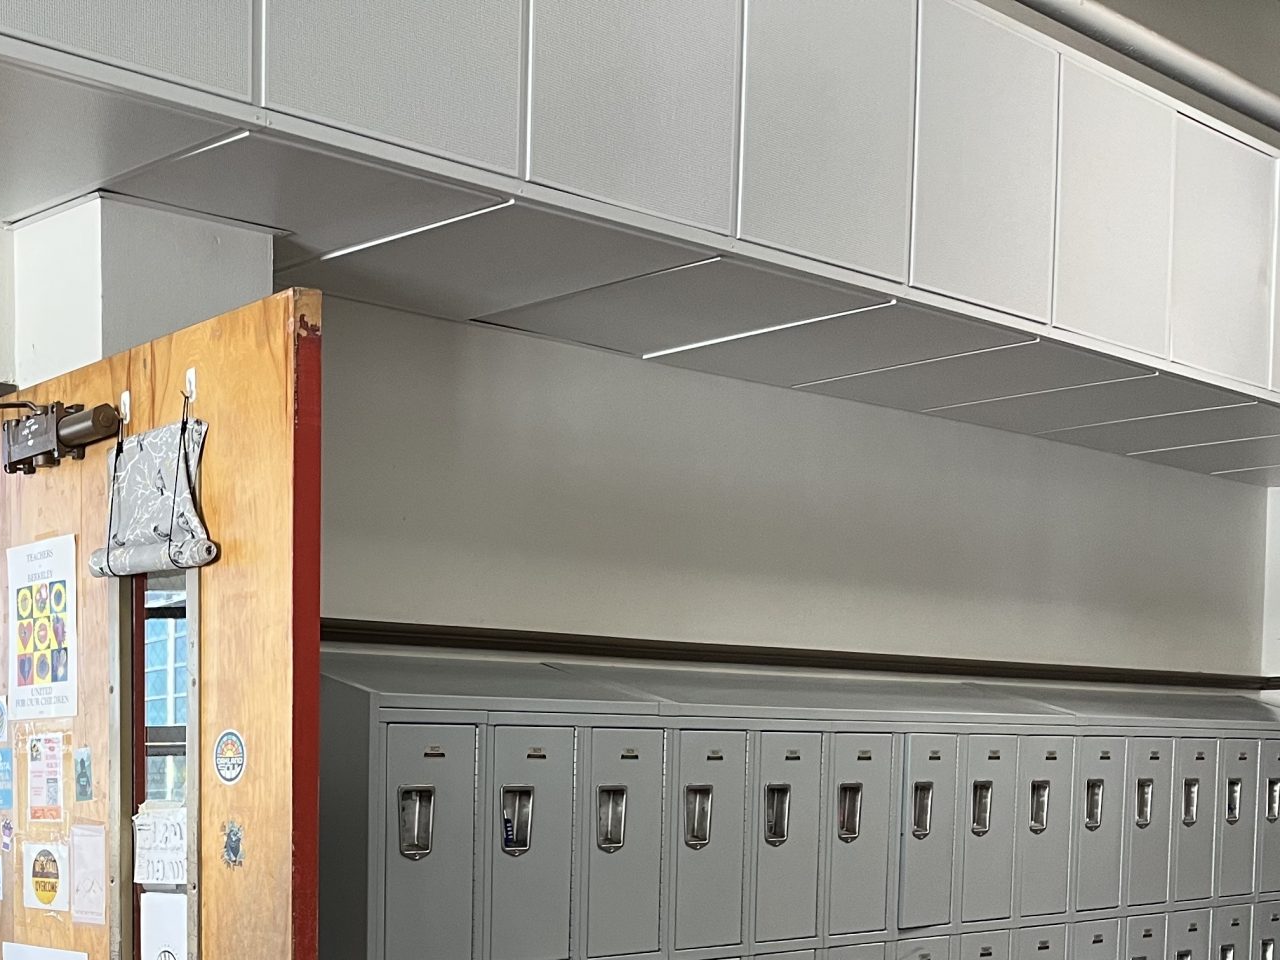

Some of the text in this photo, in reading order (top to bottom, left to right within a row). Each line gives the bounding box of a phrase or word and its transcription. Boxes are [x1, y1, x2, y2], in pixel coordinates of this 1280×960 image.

[26, 550, 54, 563] TEACHERS
[27, 570, 53, 583] BERKELEY
[30, 686, 53, 697] UNITED
[15, 698, 26, 708] FOR
[40, 695, 70, 706] CHILDREN
[34, 880, 58, 893] OVERCOME
